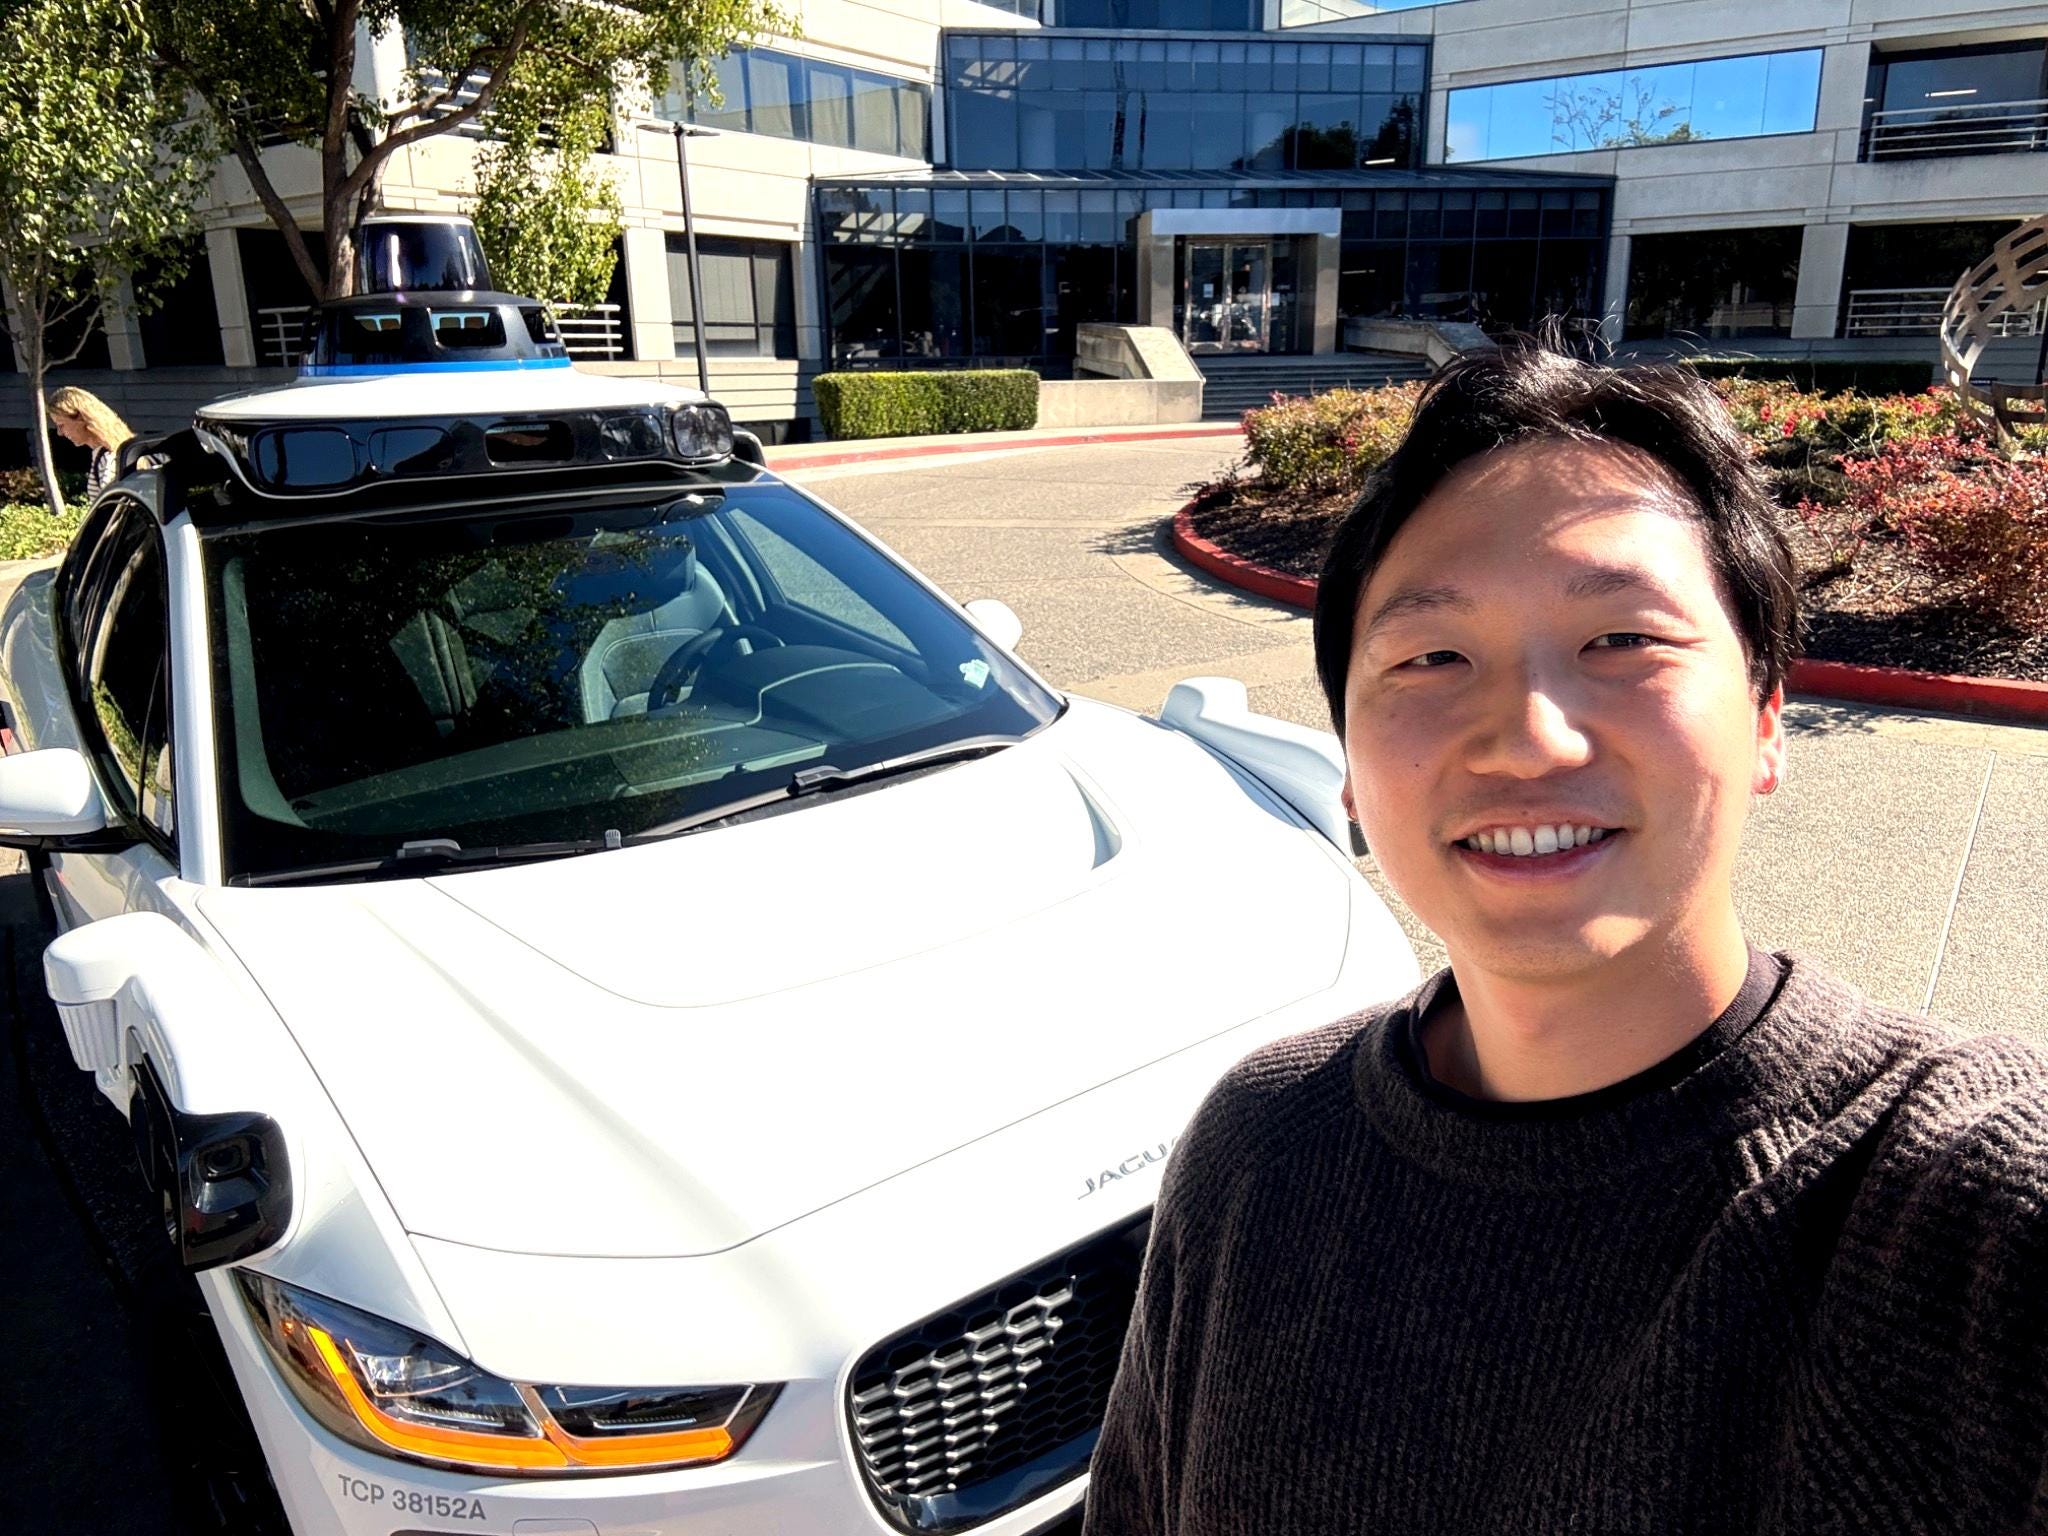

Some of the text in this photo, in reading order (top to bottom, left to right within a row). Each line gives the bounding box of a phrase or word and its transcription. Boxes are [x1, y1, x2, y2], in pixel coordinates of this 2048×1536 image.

[1077, 1136, 1178, 1200] JAGU
[338, 1474, 486, 1520] TCP 38152A
